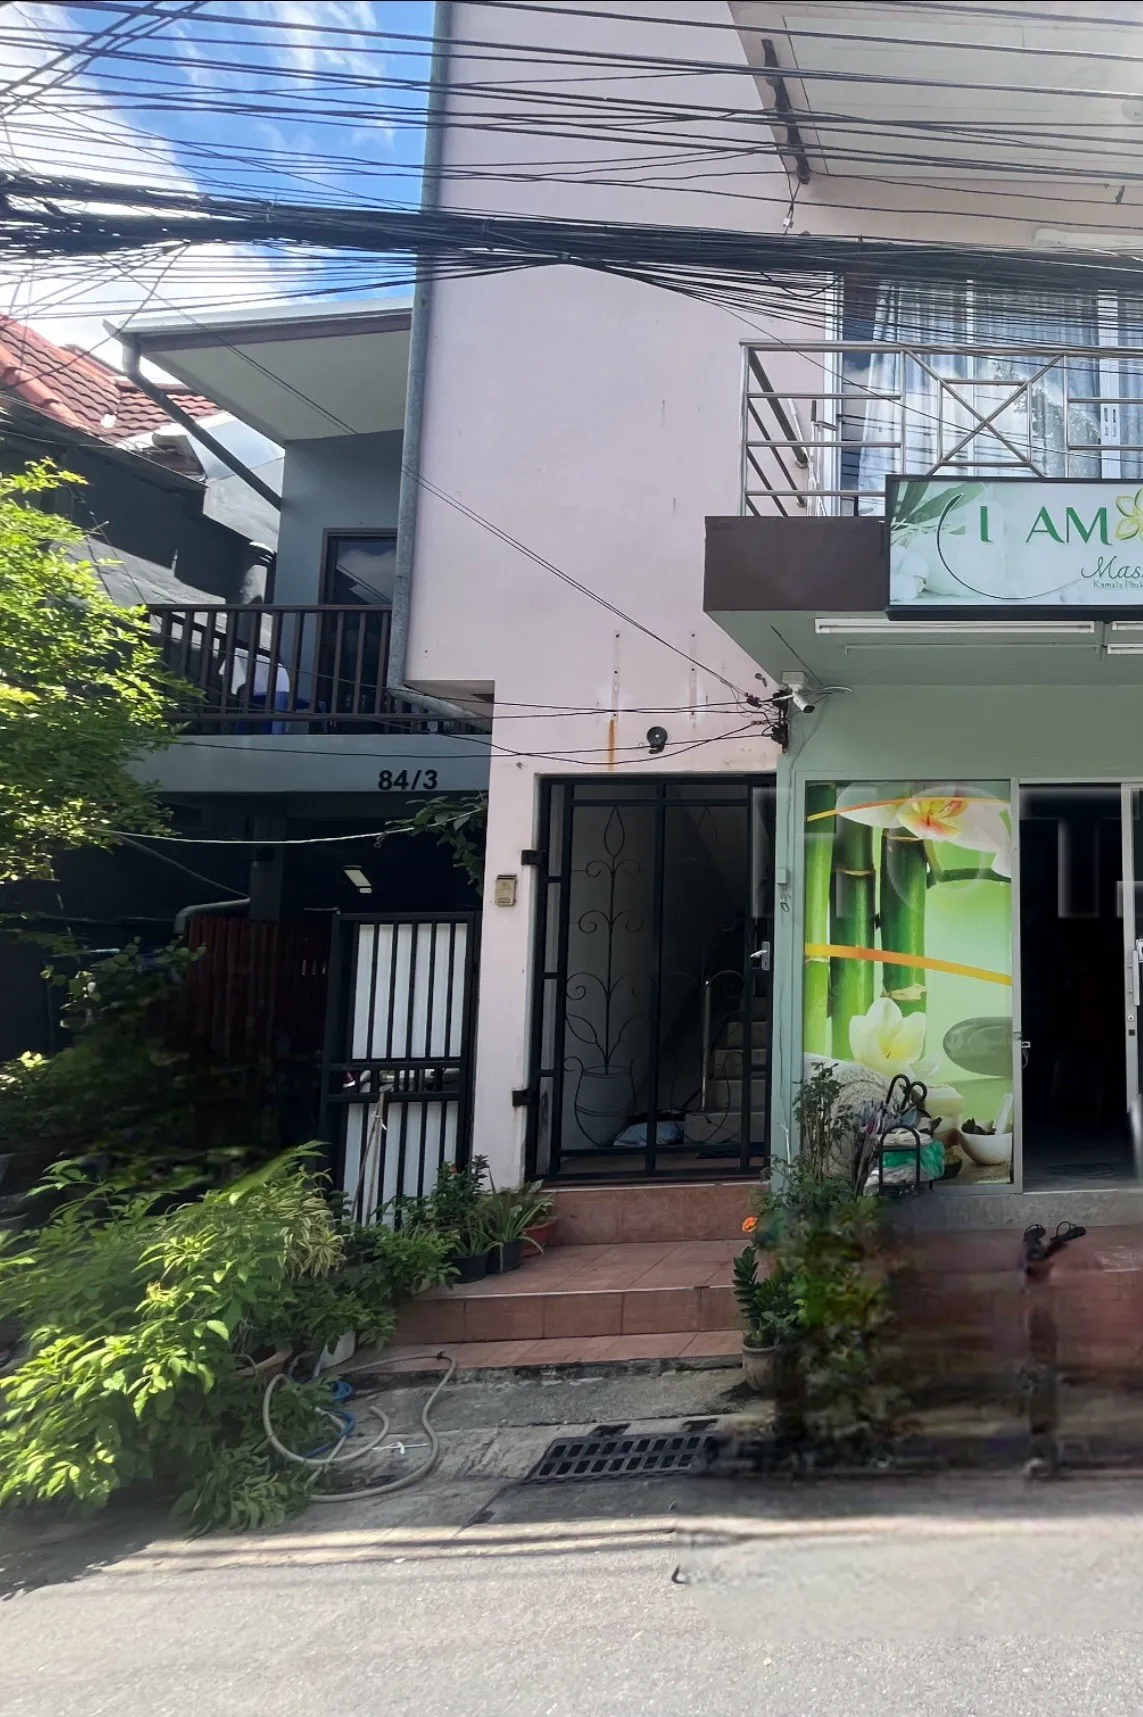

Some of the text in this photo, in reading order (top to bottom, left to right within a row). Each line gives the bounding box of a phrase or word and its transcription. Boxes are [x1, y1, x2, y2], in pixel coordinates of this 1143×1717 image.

[980, 505, 1112, 546] I AM
[378, 769, 438, 790] 84/3
